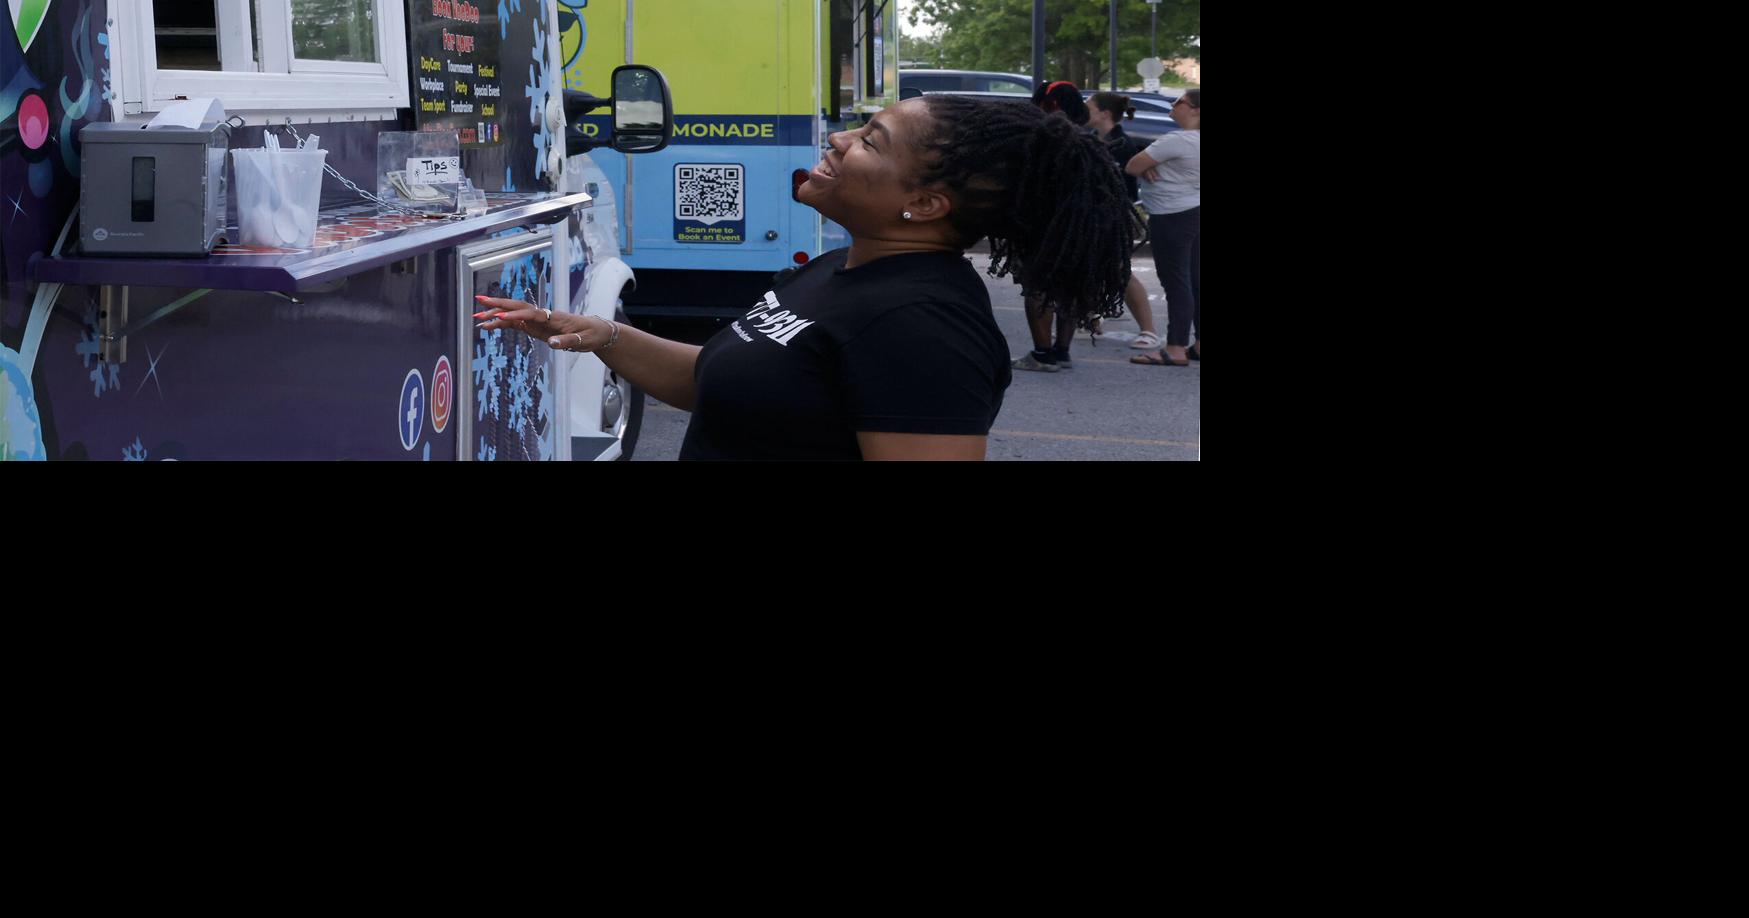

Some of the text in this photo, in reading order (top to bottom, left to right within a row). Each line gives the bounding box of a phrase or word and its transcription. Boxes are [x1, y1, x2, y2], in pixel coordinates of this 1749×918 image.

[420, 56, 495, 78] DayCare Tournament Festival
[419, 77, 500, 98] Workplace Party Special Event
[420, 98, 495, 116] Team Sport Fundraiser School
[672, 123, 774, 137] MONADE
[421, 160, 448, 175] Tips
[716, 233, 741, 241] Event
